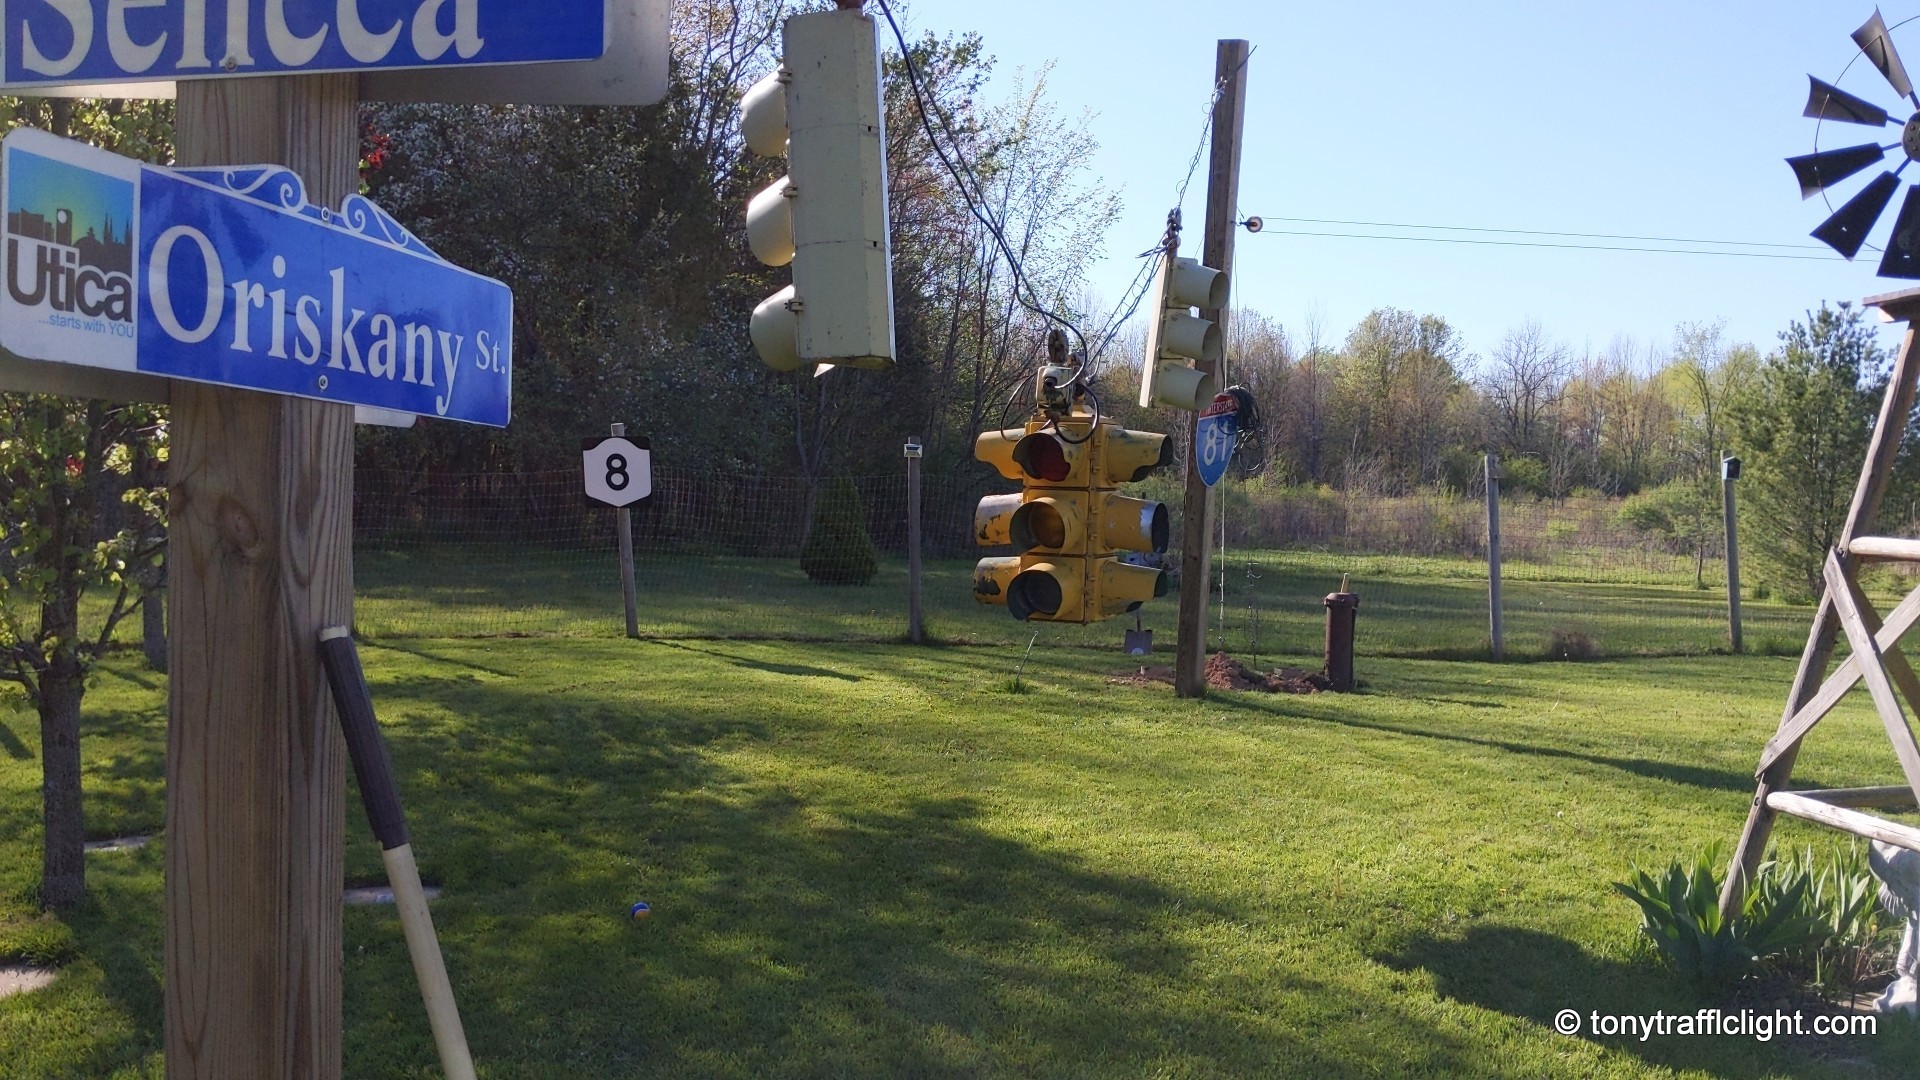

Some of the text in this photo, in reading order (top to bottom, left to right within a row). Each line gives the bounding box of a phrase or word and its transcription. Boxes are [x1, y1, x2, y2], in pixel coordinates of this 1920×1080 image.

[8, 238, 133, 323] Utica
[84, 319, 106, 334] with
[109, 322, 134, 338] YOU
[149, 225, 506, 415] Oriskany St.
[1204, 420, 1230, 466] 81
[605, 453, 630, 491] 8
